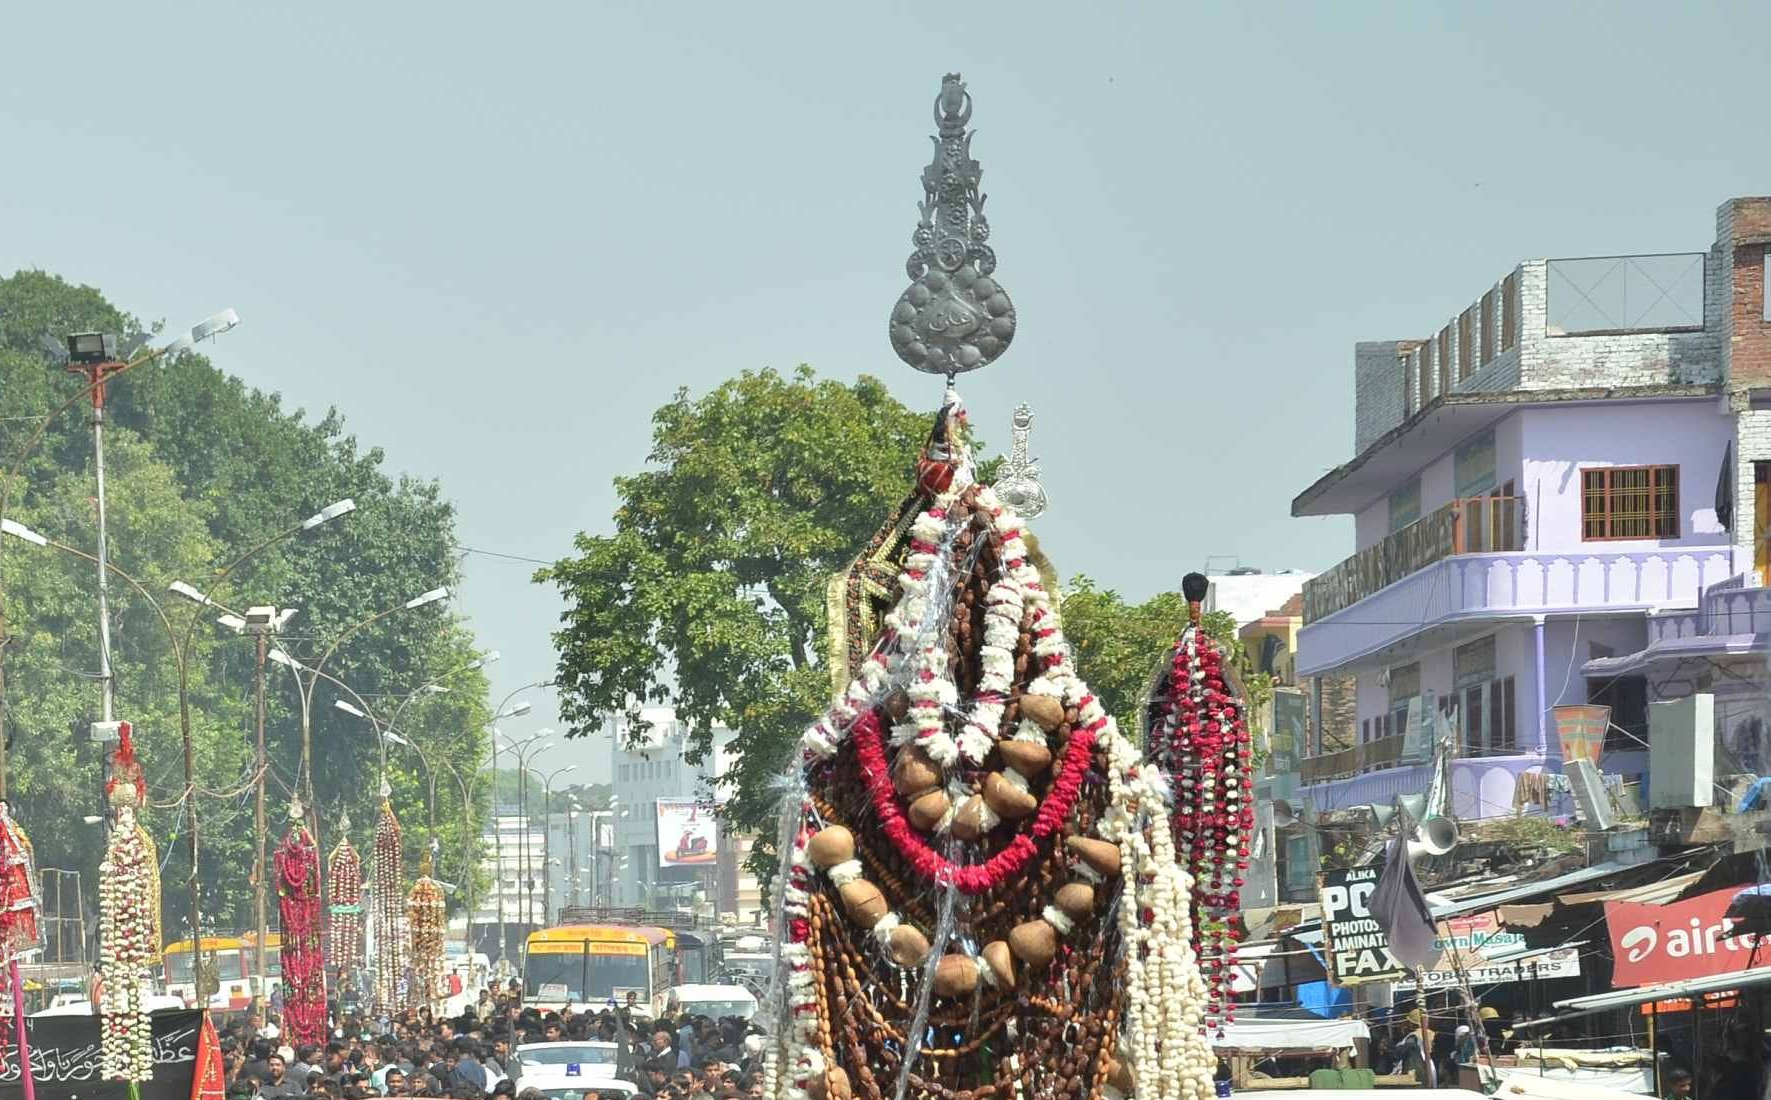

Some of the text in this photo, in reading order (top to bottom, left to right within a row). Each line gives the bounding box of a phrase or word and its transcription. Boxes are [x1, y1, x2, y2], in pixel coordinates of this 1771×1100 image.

[1320, 882, 1375, 921] PC
[1331, 919, 1380, 937] PHOTOS
[1336, 947, 1406, 977] FAX
